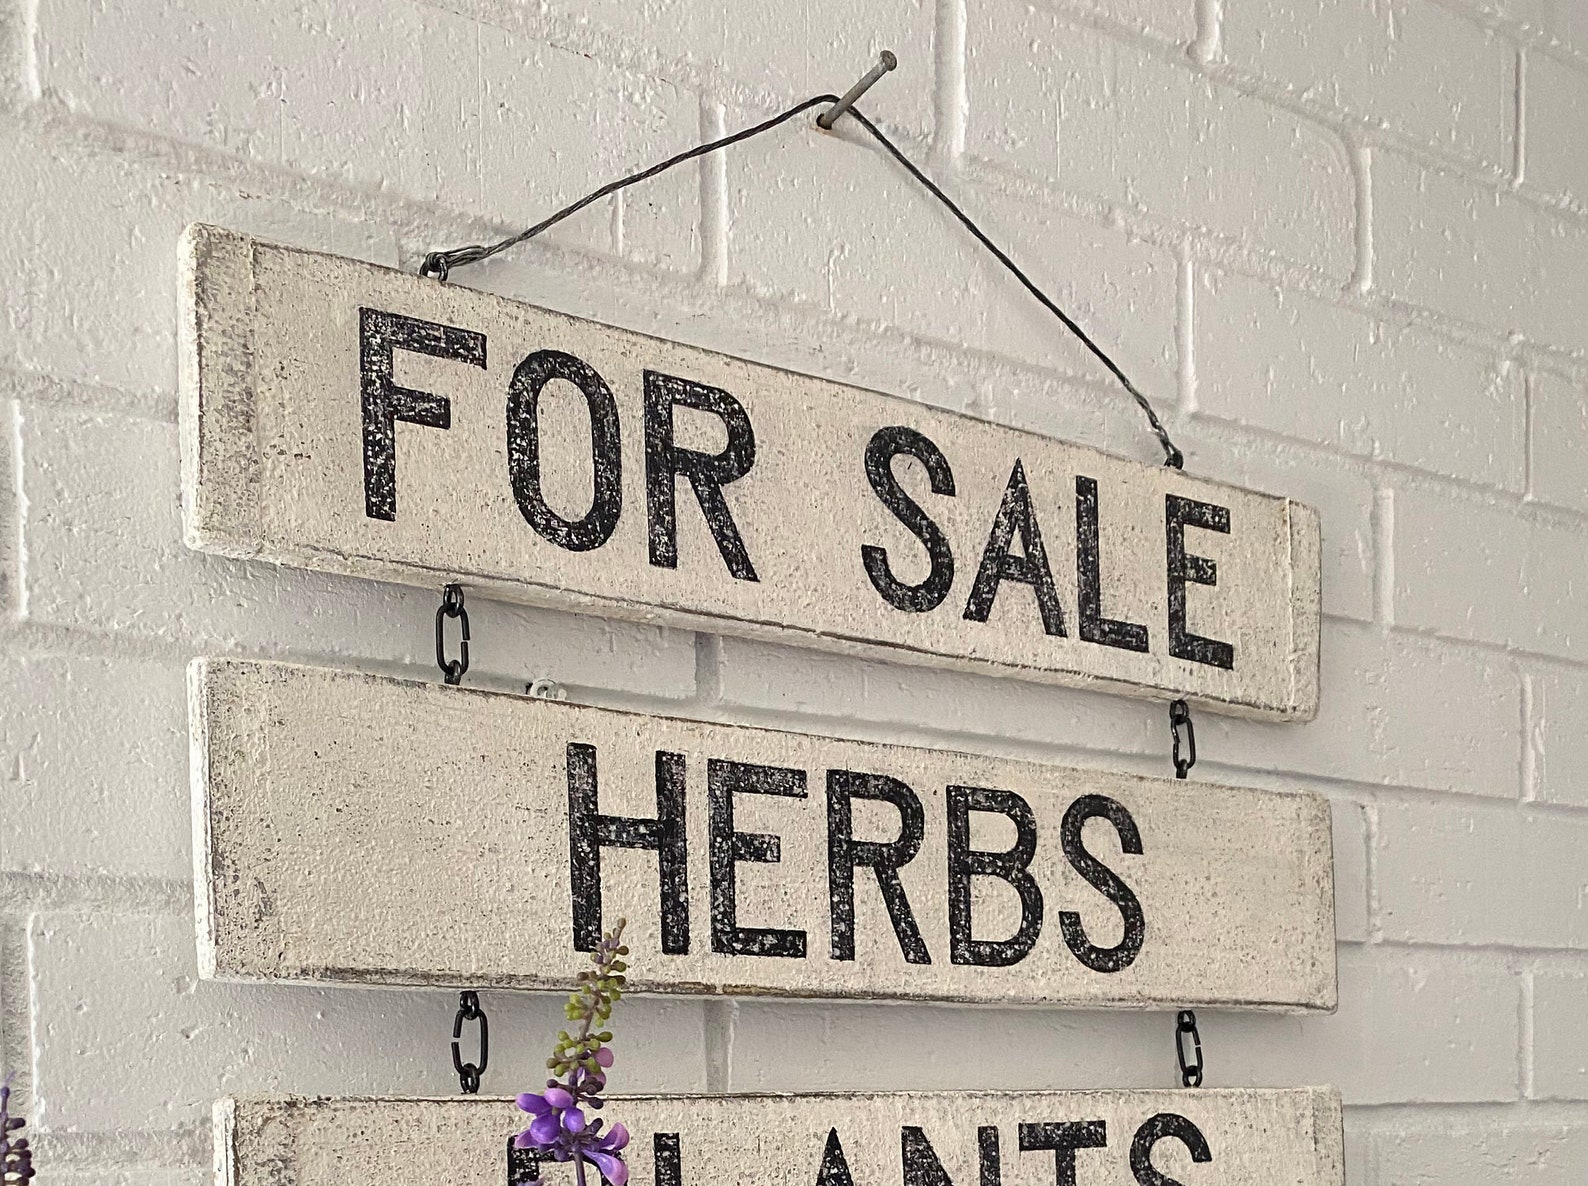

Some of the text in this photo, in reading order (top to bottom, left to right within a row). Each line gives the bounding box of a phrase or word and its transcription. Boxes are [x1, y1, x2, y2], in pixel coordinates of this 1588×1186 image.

[359, 307, 1234, 670] FOR SALE
[567, 743, 1146, 973] HERBS
